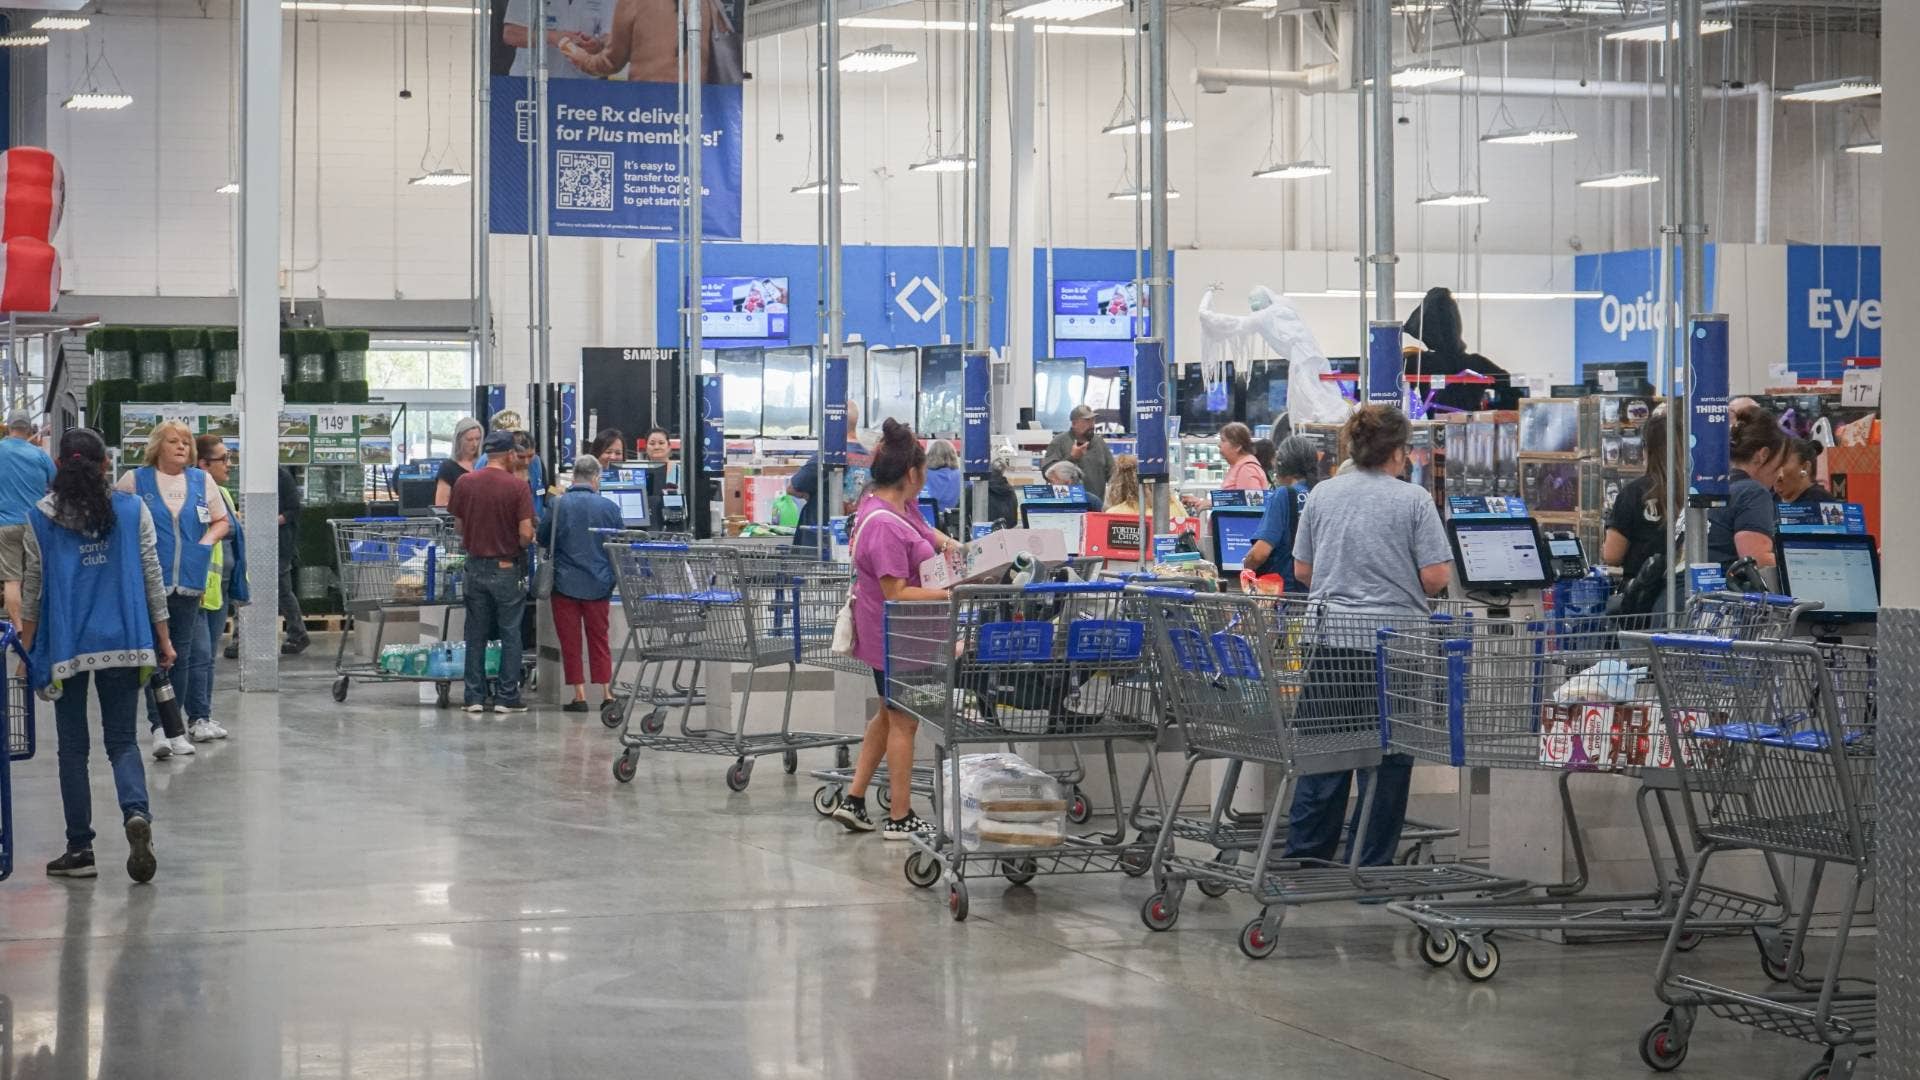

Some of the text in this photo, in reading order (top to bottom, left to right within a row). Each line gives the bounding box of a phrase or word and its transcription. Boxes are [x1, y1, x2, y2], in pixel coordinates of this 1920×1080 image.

[557, 104, 597, 121] Free
[601, 105, 625, 122] Rx
[556, 124, 583, 141] for
[587, 126, 624, 142] Plus
[624, 160, 676, 172] It's easy to
[624, 173, 662, 182] transfer
[624, 183, 648, 194] Scan
[649, 185, 666, 194] the
[623, 196, 634, 205] to
[636, 197, 653, 207] get
[1808, 288, 1882, 339] Eye
[82, 552, 107, 567] club
